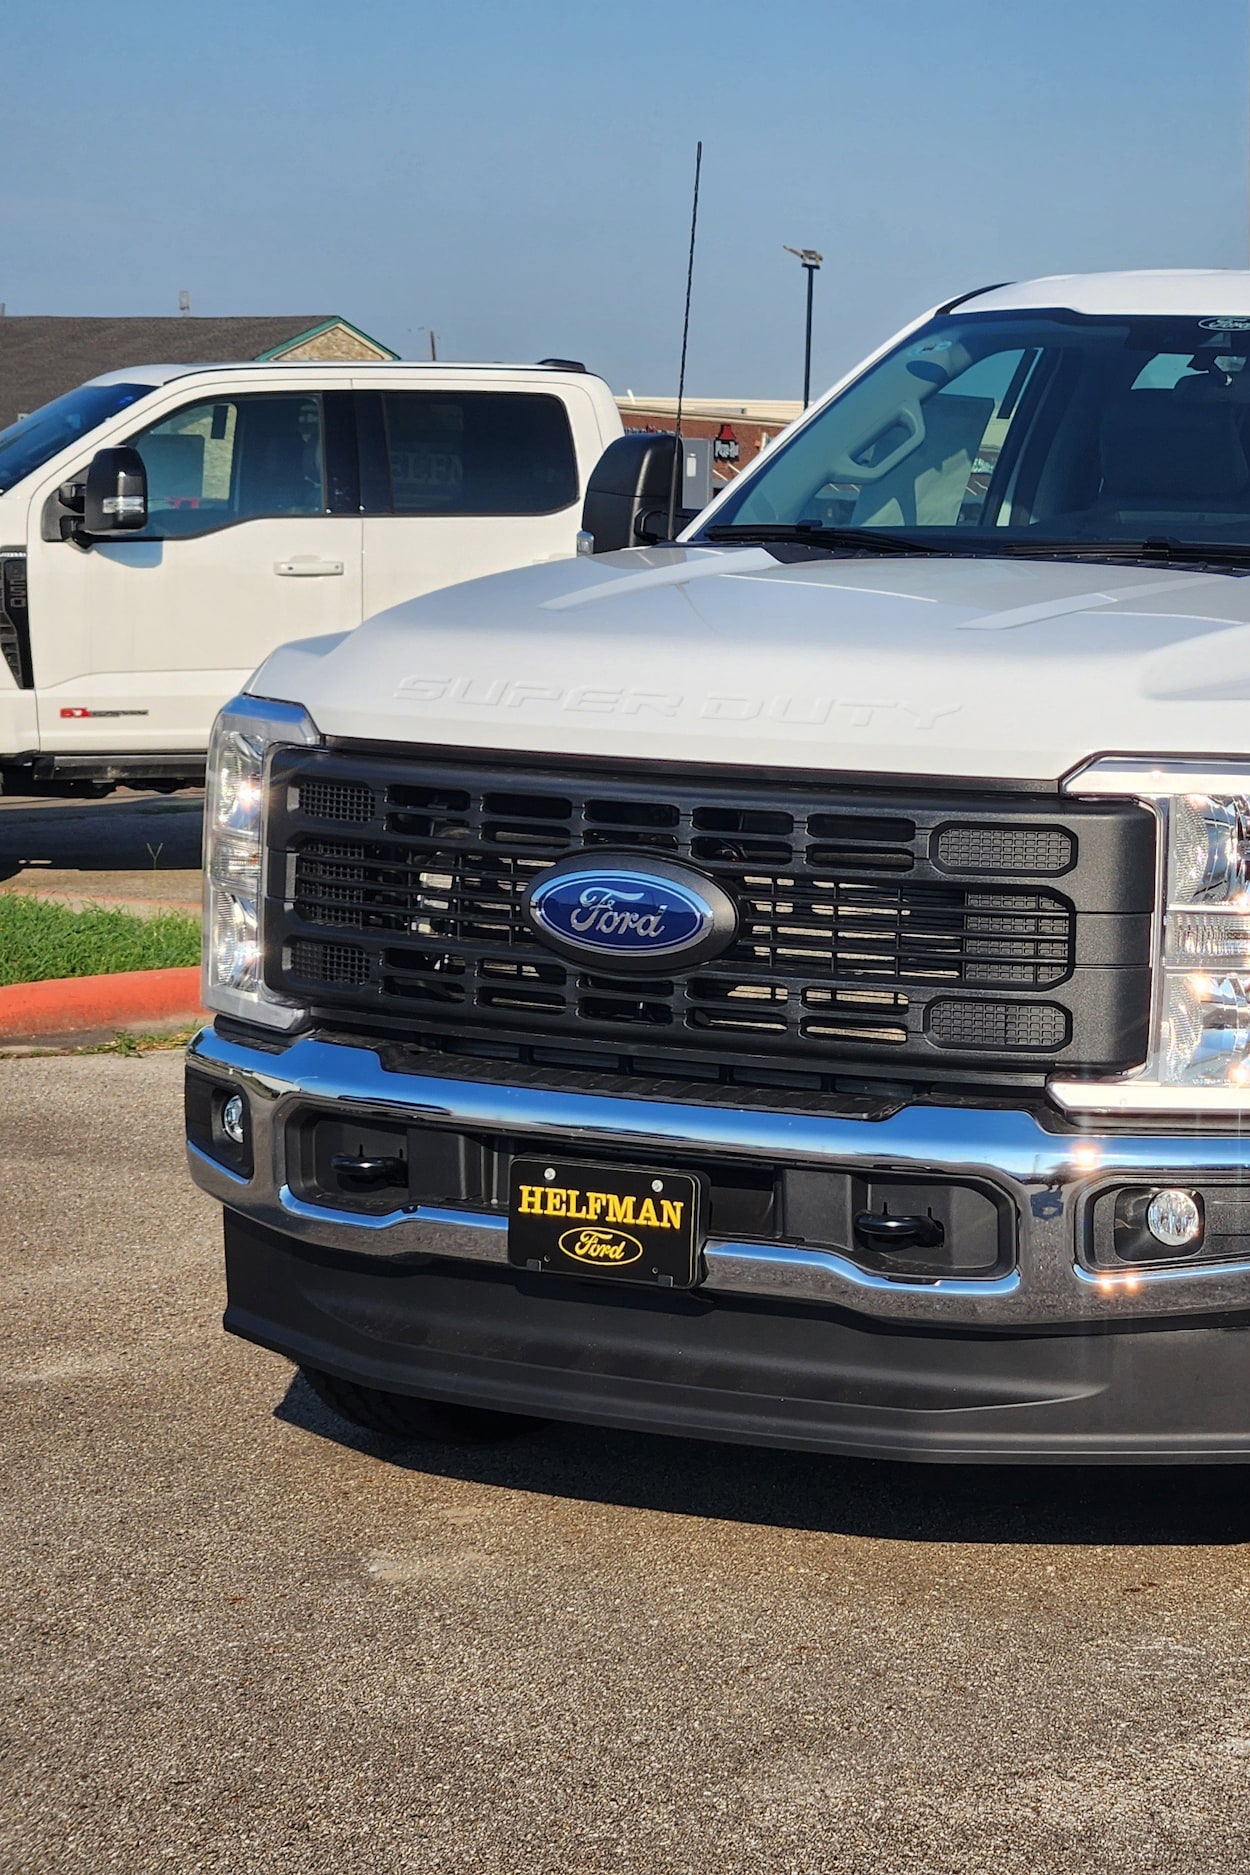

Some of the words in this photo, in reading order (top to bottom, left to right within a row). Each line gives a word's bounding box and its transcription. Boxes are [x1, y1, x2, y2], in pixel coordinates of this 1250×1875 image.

[391, 673, 685, 718] SUPER
[698, 690, 964, 730] DUTY
[570, 886, 669, 938] Ford
[517, 1185, 685, 1230] HELFMAN
[574, 1230, 627, 1261] Ford
